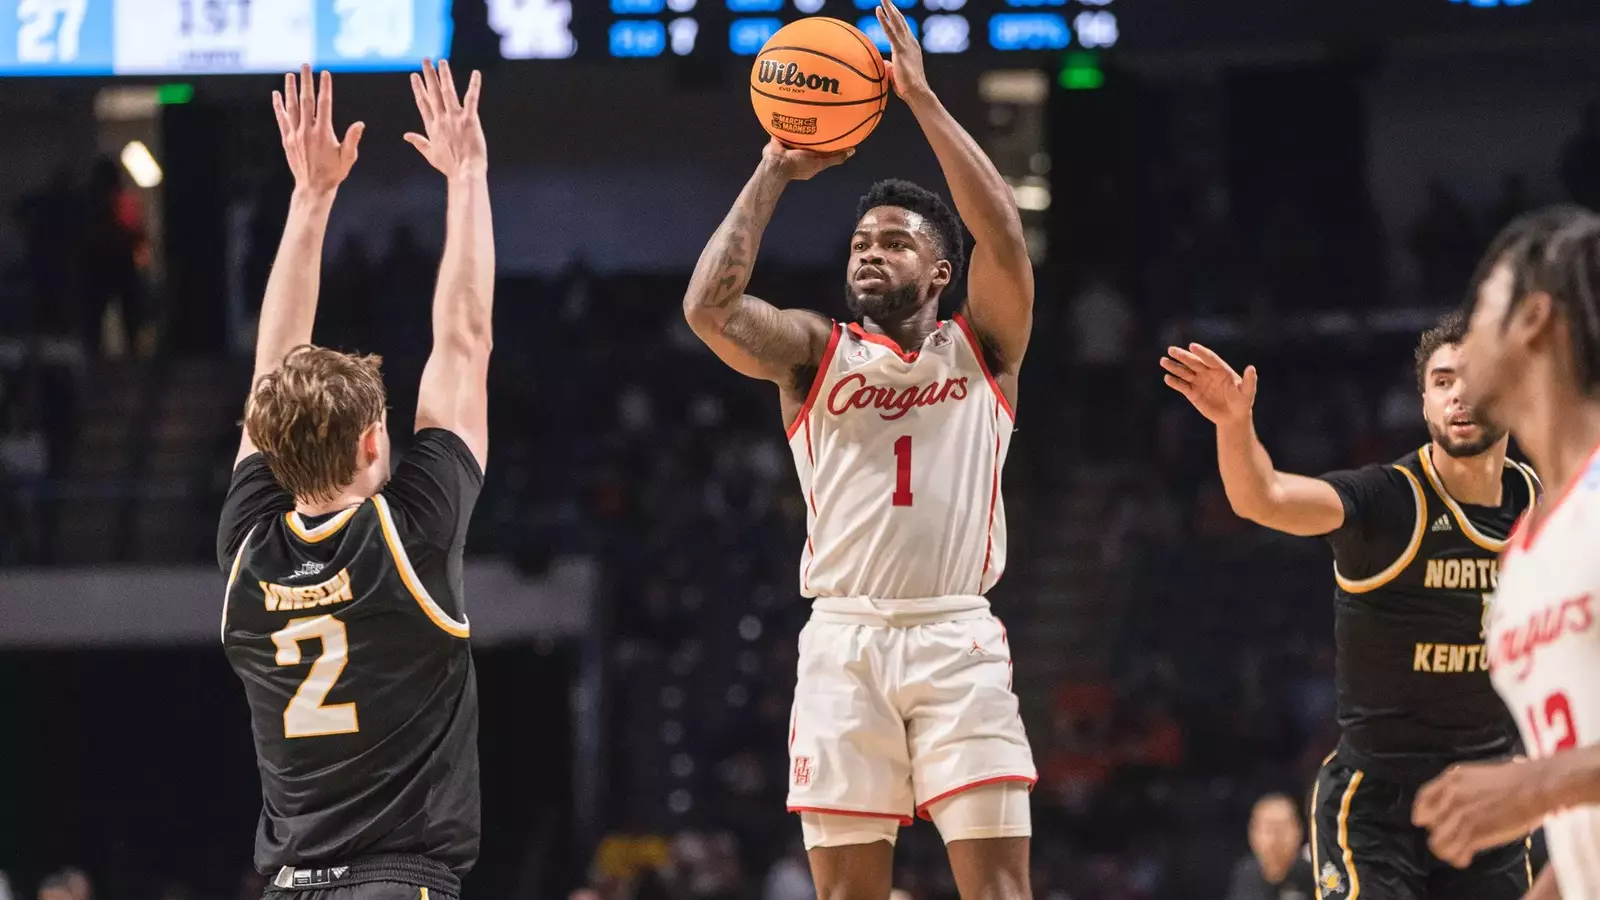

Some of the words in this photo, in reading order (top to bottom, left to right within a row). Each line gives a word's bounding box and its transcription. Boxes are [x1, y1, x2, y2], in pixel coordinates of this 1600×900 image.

[758, 60, 840, 95] Wilson
[781, 115, 804, 126] MARCH
[782, 123, 817, 135] MADNESS
[827, 373, 968, 420] Cougars
[892, 435, 913, 506] 1
[271, 614, 359, 738] 2
